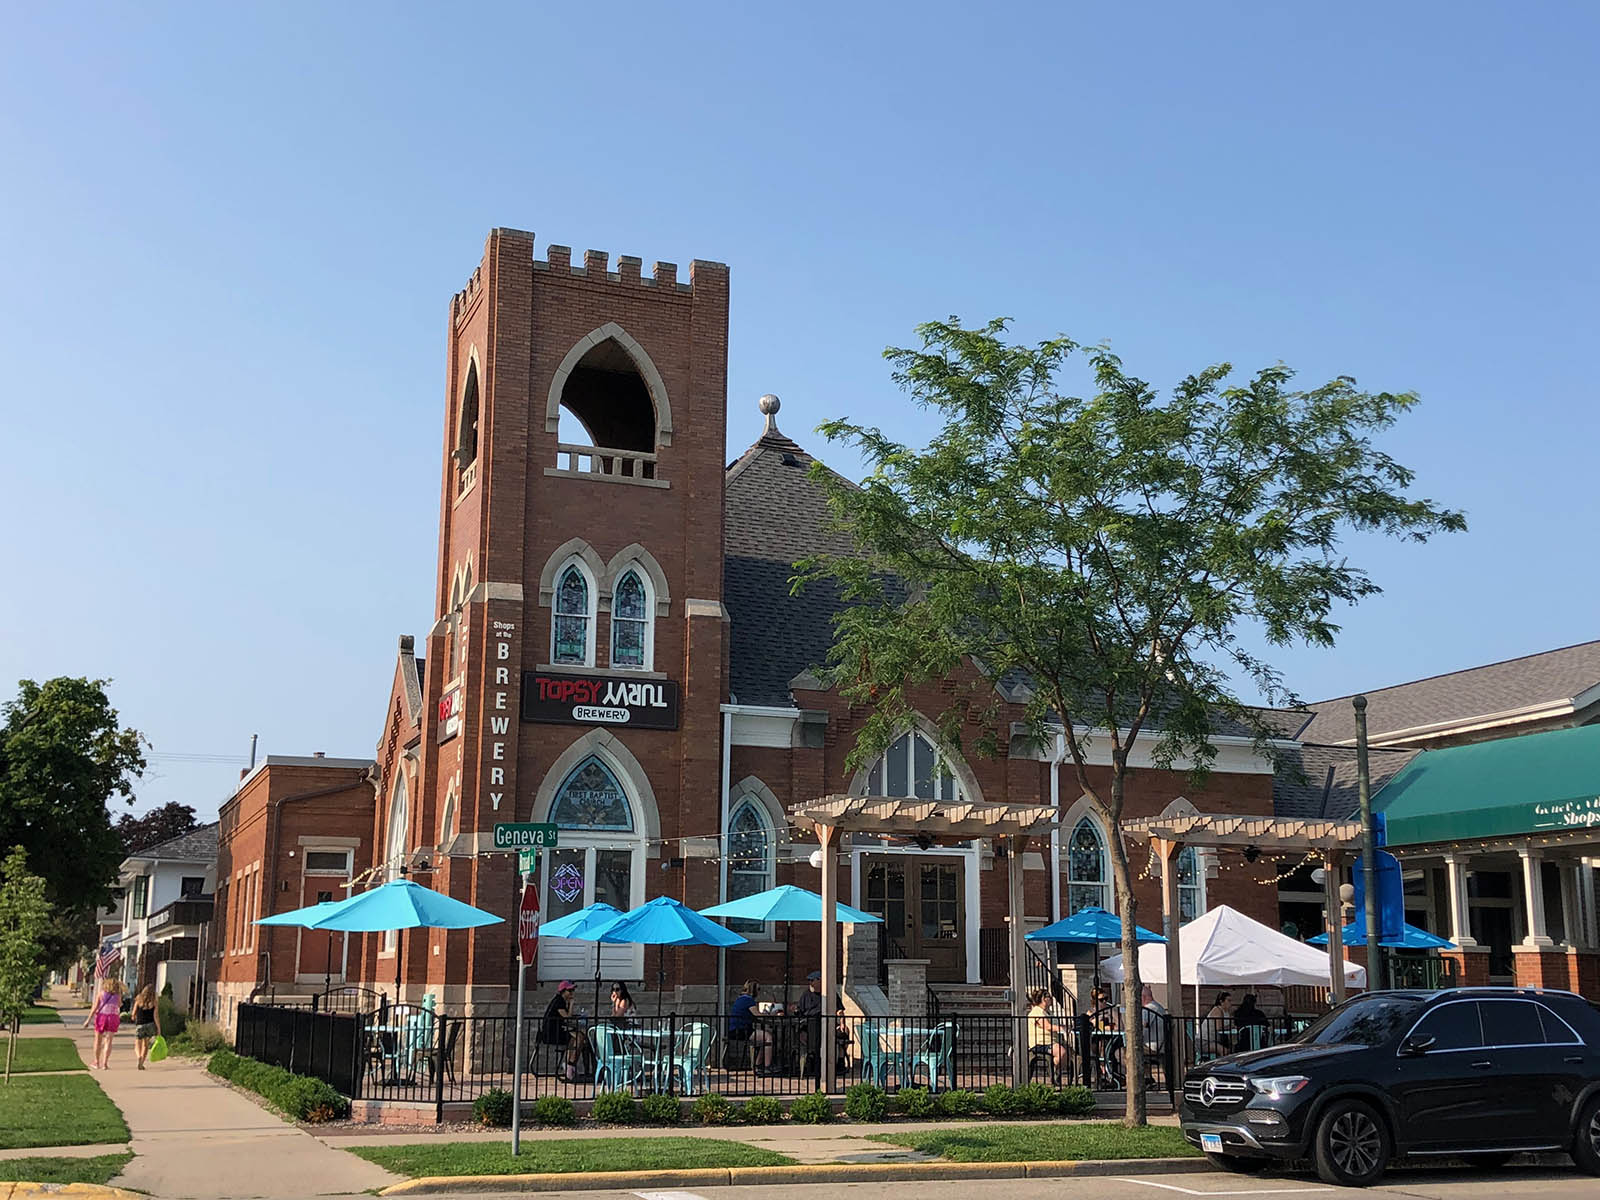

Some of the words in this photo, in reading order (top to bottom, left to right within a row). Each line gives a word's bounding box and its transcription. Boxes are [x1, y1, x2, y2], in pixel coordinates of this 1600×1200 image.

[493, 621, 515, 630] Shops
[535, 677, 603, 704] TOPSY
[602, 681, 667, 707] TURVY
[577, 707, 626, 720] BREWERY
[490, 642, 509, 811] BREWERY
[589, 791, 618, 799] BAPTIST
[496, 826, 544, 845] Geneva
[548, 830, 556, 840] St
[549, 876, 584, 890] OPEN
[520, 909, 540, 939] STOP
